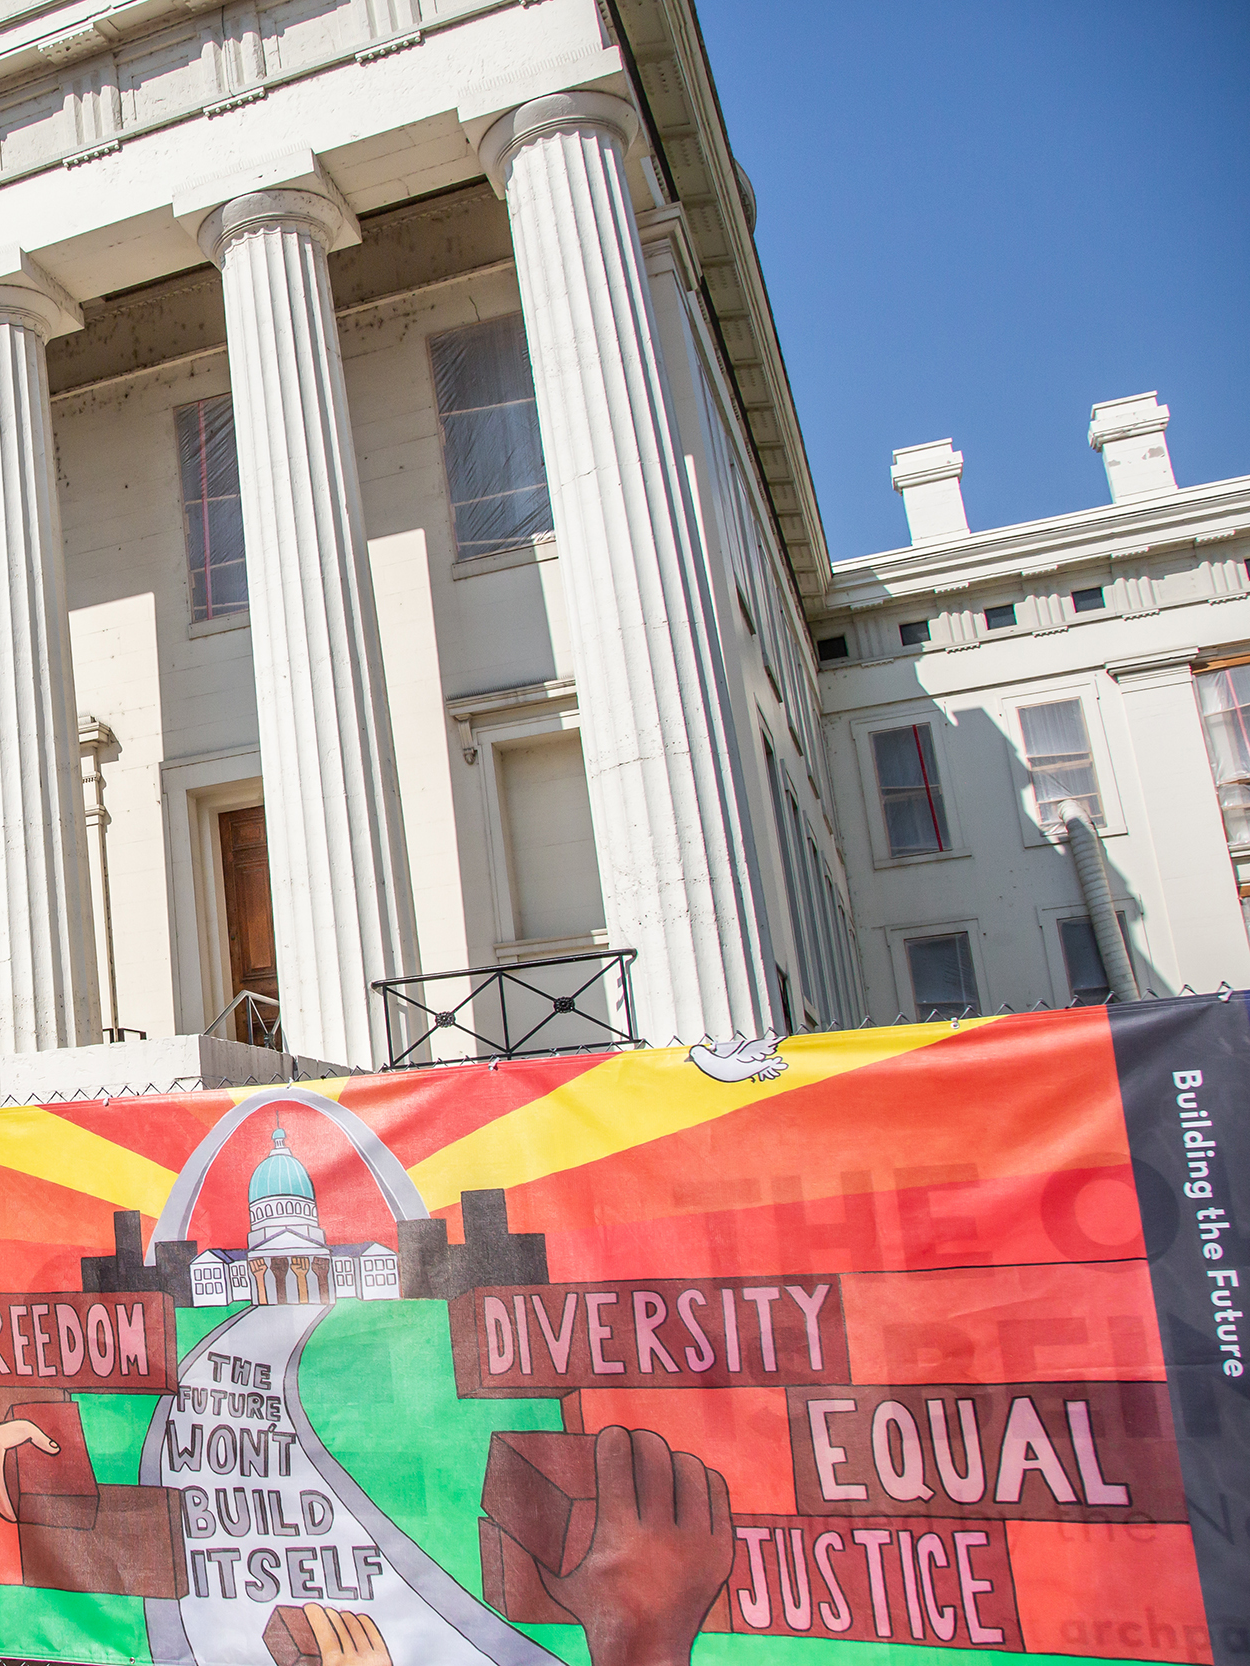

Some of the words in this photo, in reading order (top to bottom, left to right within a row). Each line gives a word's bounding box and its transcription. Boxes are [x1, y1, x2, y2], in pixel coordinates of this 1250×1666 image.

[1172, 1069, 1216, 1200] Building
[1196, 1207, 1230, 1260] the
[483, 1283, 830, 1379] DIVERSITY
[1206, 1269, 1244, 1378] Future
[176, 1385, 282, 1423] FUTURE
[207, 1352, 272, 1391] THE
[806, 1396, 1133, 1507] EQUAL
[183, 1484, 335, 1540] BUILD
[190, 1545, 383, 1603] ITSELF
[734, 1524, 1006, 1645] JUSTICE
